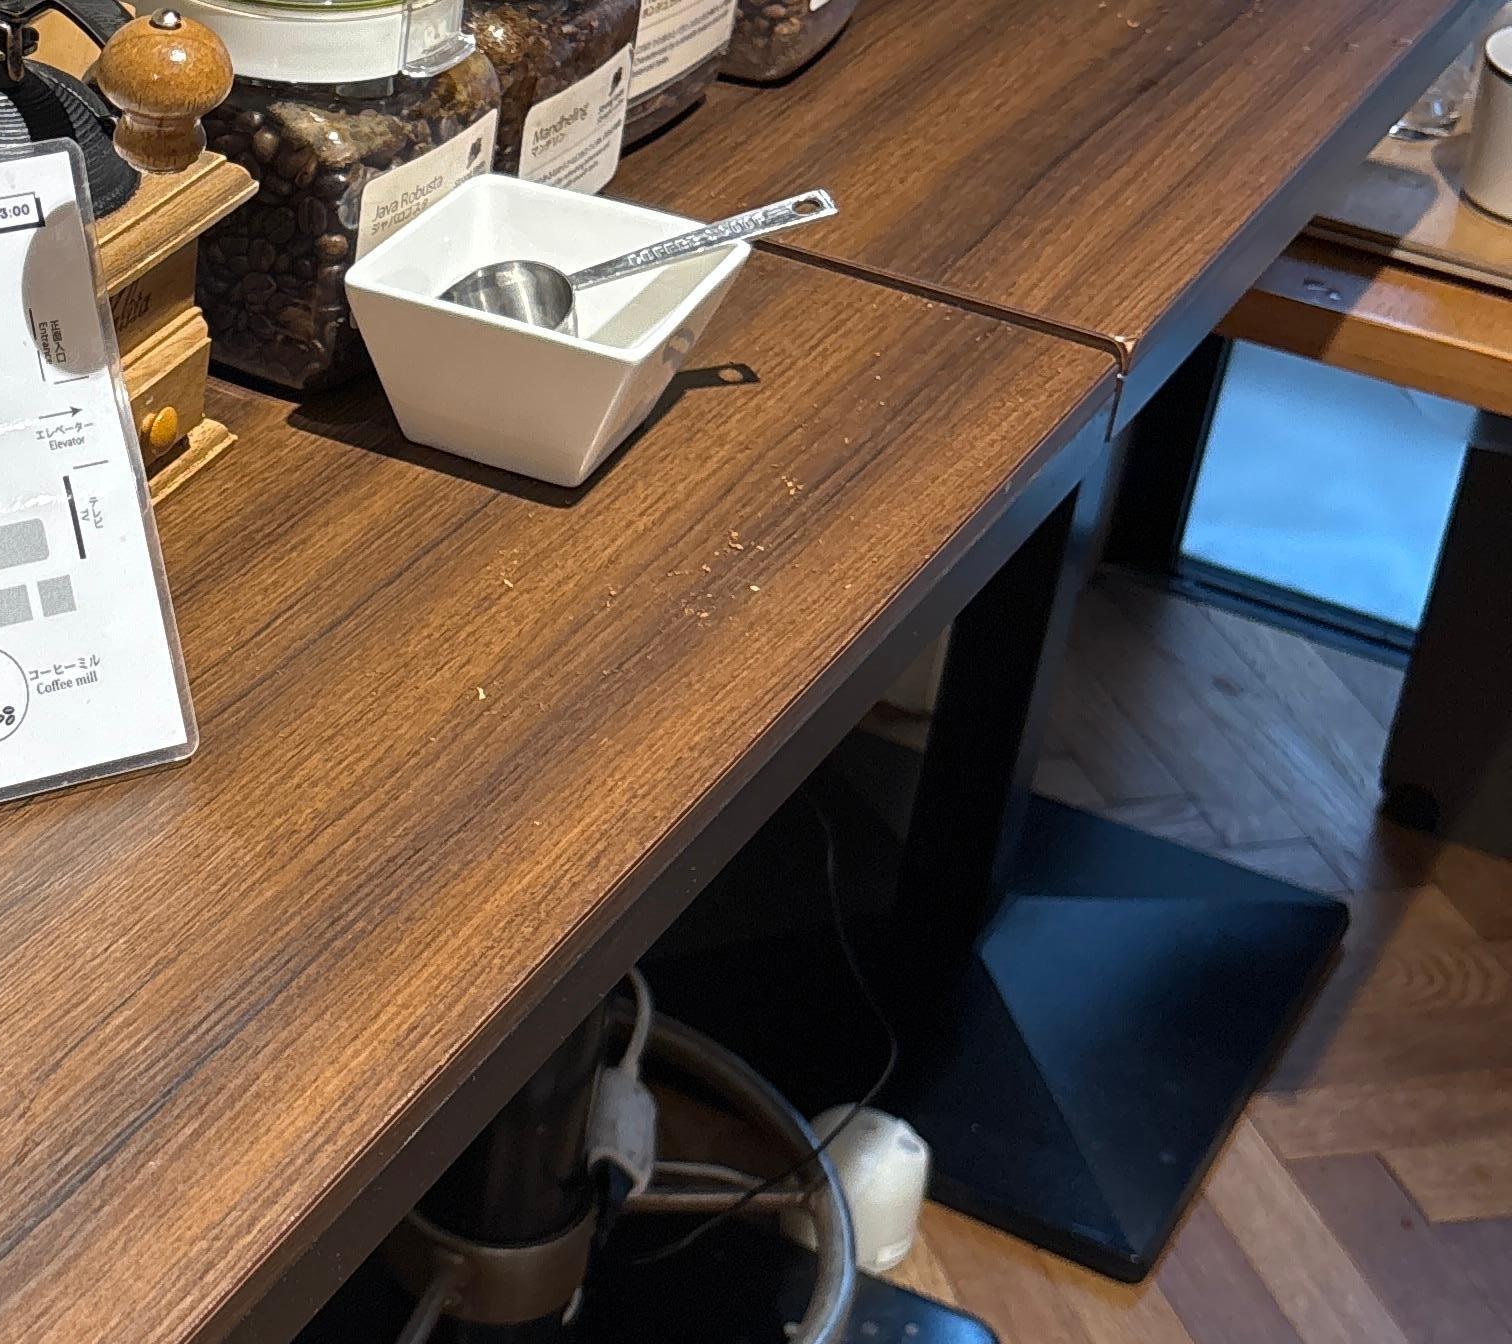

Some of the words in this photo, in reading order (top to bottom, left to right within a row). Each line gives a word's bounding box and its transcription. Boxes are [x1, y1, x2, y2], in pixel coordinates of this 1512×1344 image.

[372, 198, 400, 223] Java
[399, 174, 444, 209] Robusta
[38, 321, 54, 365] Entrance
[49, 319, 67, 364] 正面入口
[35, 422, 94, 441] エレベーター
[49, 436, 87, 451] Elevator
[81, 509, 90, 522] TV
[29, 655, 101, 682] コーヒーミル
[36, 678, 73, 696] Coffee
[75, 670, 99, 688] mill
